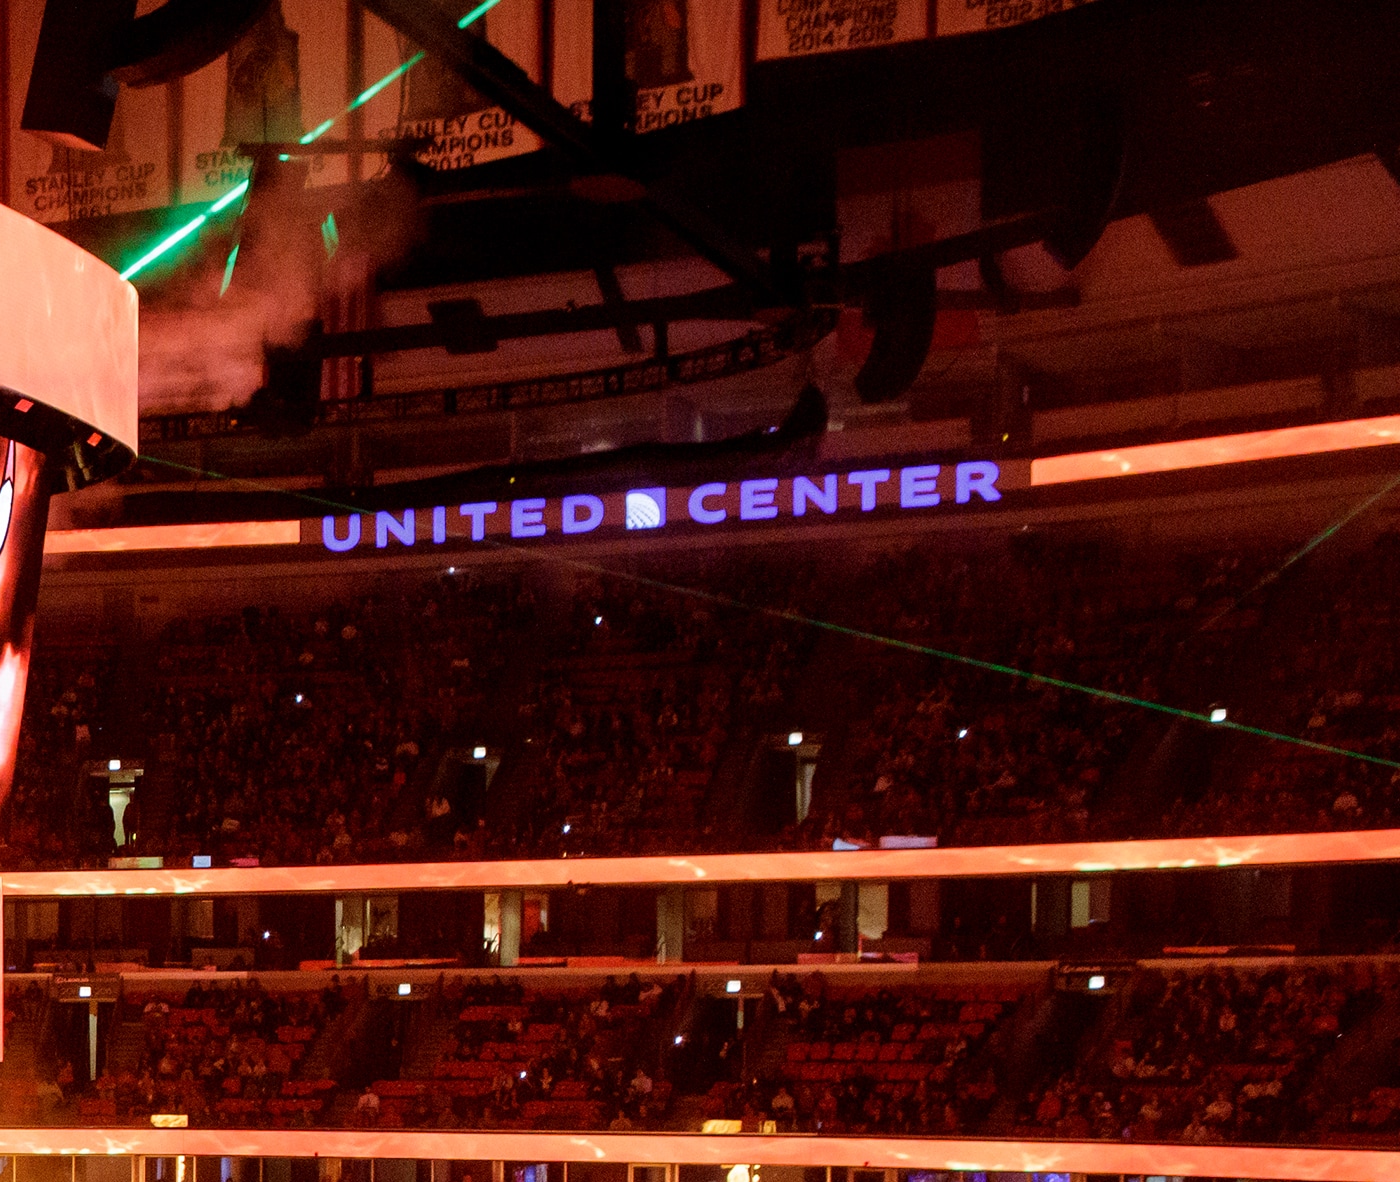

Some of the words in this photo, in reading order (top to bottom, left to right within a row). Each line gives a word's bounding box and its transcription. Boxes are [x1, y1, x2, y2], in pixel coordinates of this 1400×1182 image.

[676, 83, 725, 106] CUP
[25, 169, 107, 196] STANLEY
[115, 162, 156, 181] CUP
[34, 182, 148, 212] CHAMPIONS
[321, 494, 605, 553] UNITED
[687, 460, 1004, 527] CENTER
